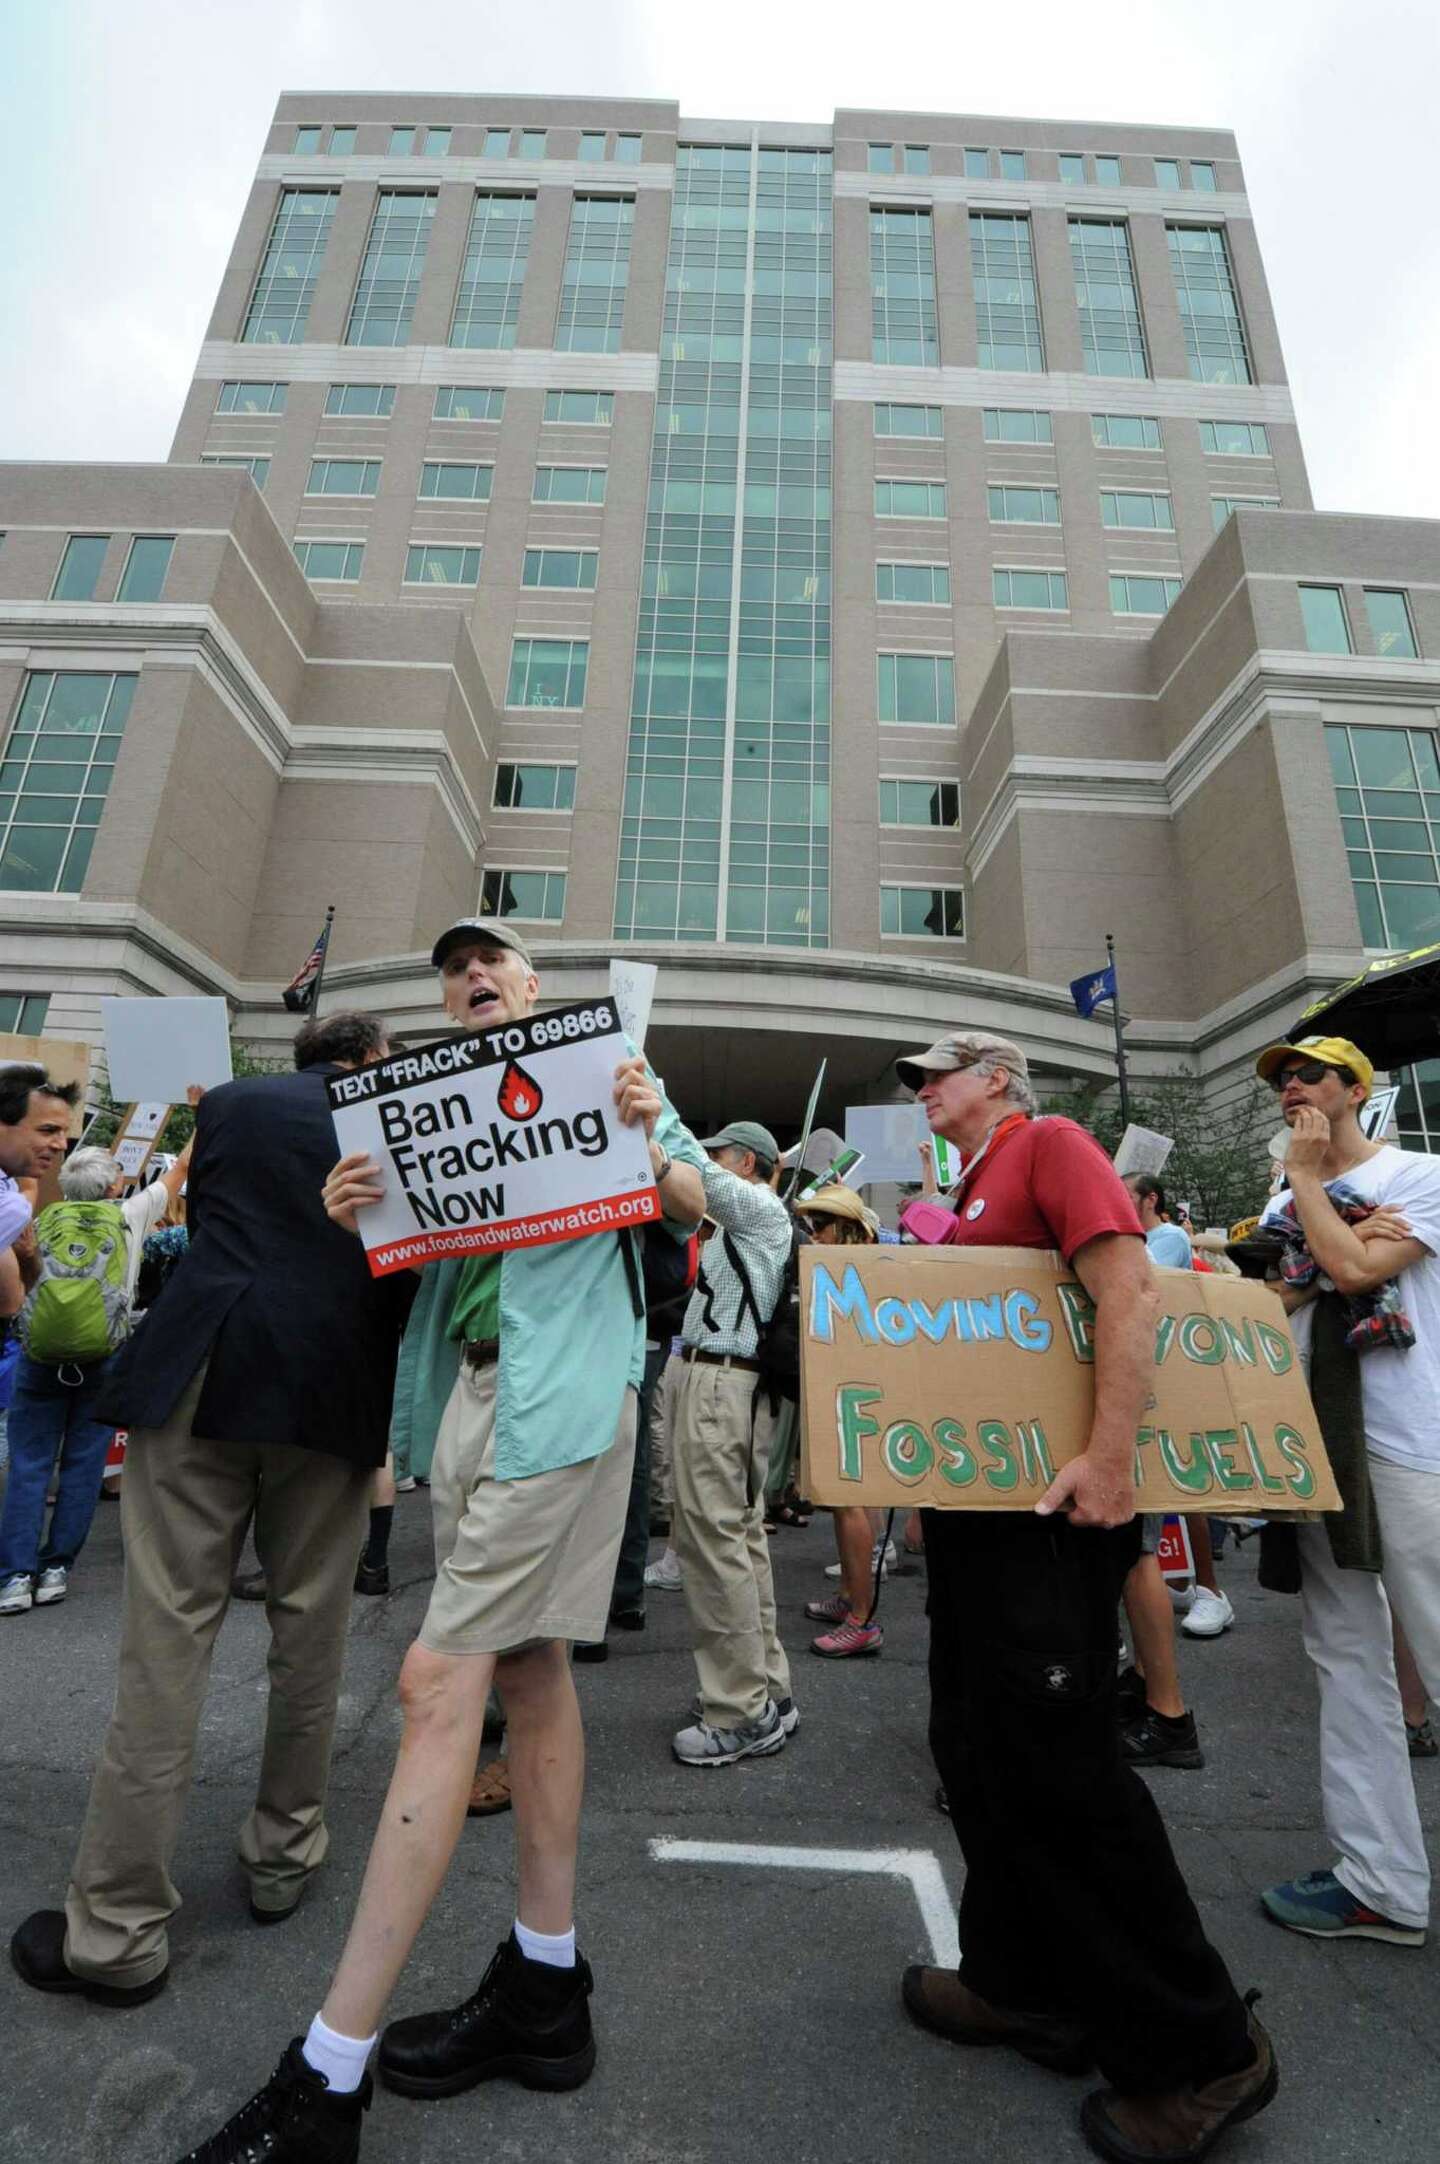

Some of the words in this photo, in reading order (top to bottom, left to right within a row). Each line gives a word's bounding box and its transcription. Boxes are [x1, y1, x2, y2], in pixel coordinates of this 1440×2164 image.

[330, 1069, 379, 1102] TEXT
[486, 1028, 526, 1056] TO
[530, 1006, 613, 1045] 69866
[377, 1093, 473, 1145] Ban
[390, 1107, 609, 1189] Fracking
[376, 1195, 655, 1267] www.foodandwaterwatch.org
[405, 1184, 505, 1229] Now
[808, 1262, 1054, 1353] MOVING
[1056, 1282, 1293, 1376] BYOND
[834, 1382, 1059, 1492] FOSSIL
